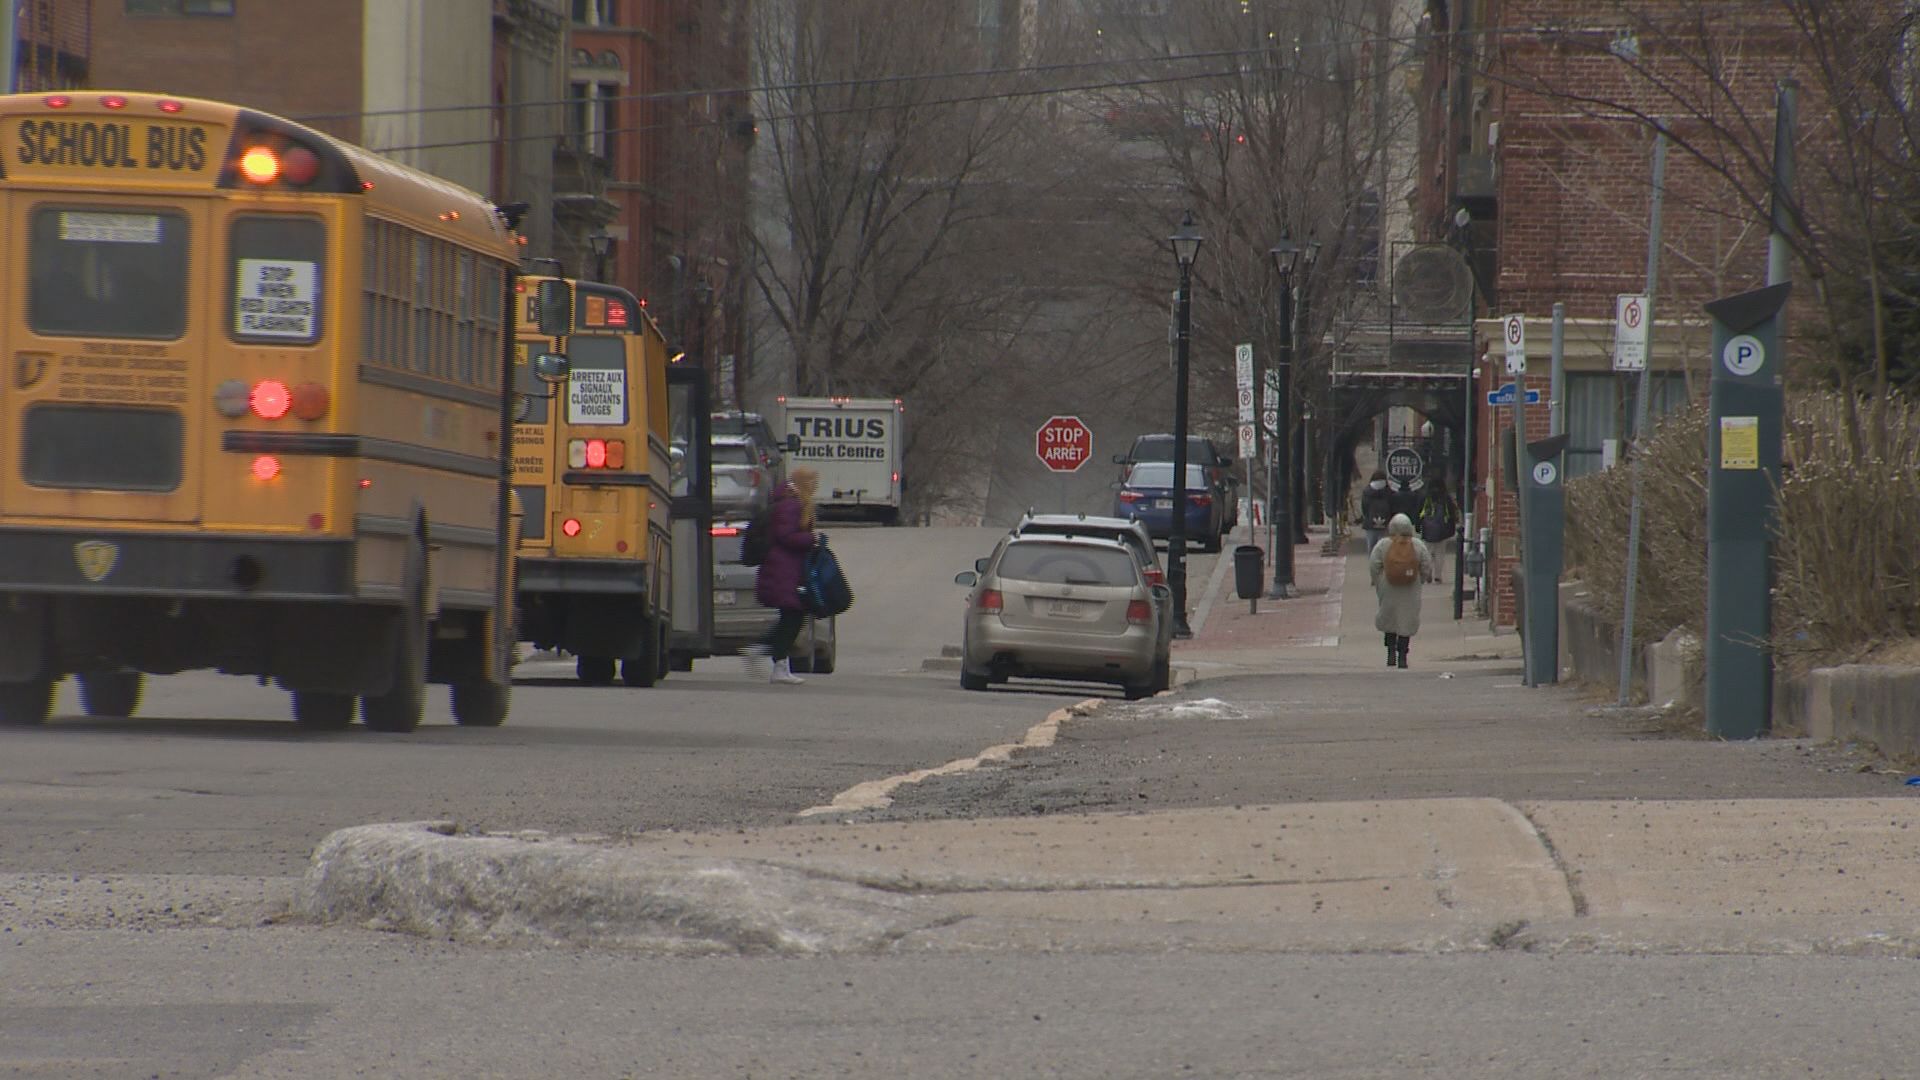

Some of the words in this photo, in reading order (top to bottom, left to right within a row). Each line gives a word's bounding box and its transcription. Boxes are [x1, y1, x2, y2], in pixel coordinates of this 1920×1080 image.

[18, 119, 138, 168] SCHOOL
[146, 125, 207, 171] BUS
[260, 266, 294, 281] STOP
[240, 299, 264, 313] RED
[268, 300, 311, 316] LIGHTS
[1738, 346, 1752, 364] P
[607, 372, 622, 383] AUX
[580, 383, 613, 393] SIGNAUX
[571, 393, 621, 405] CLIGNOTANTS
[581, 405, 611, 416] ROUGES
[794, 417, 884, 439] TRIUS
[1045, 427, 1083, 443] STOP
[837, 444, 884, 458] Centre
[1045, 444, 1083, 460] ARRÊT
